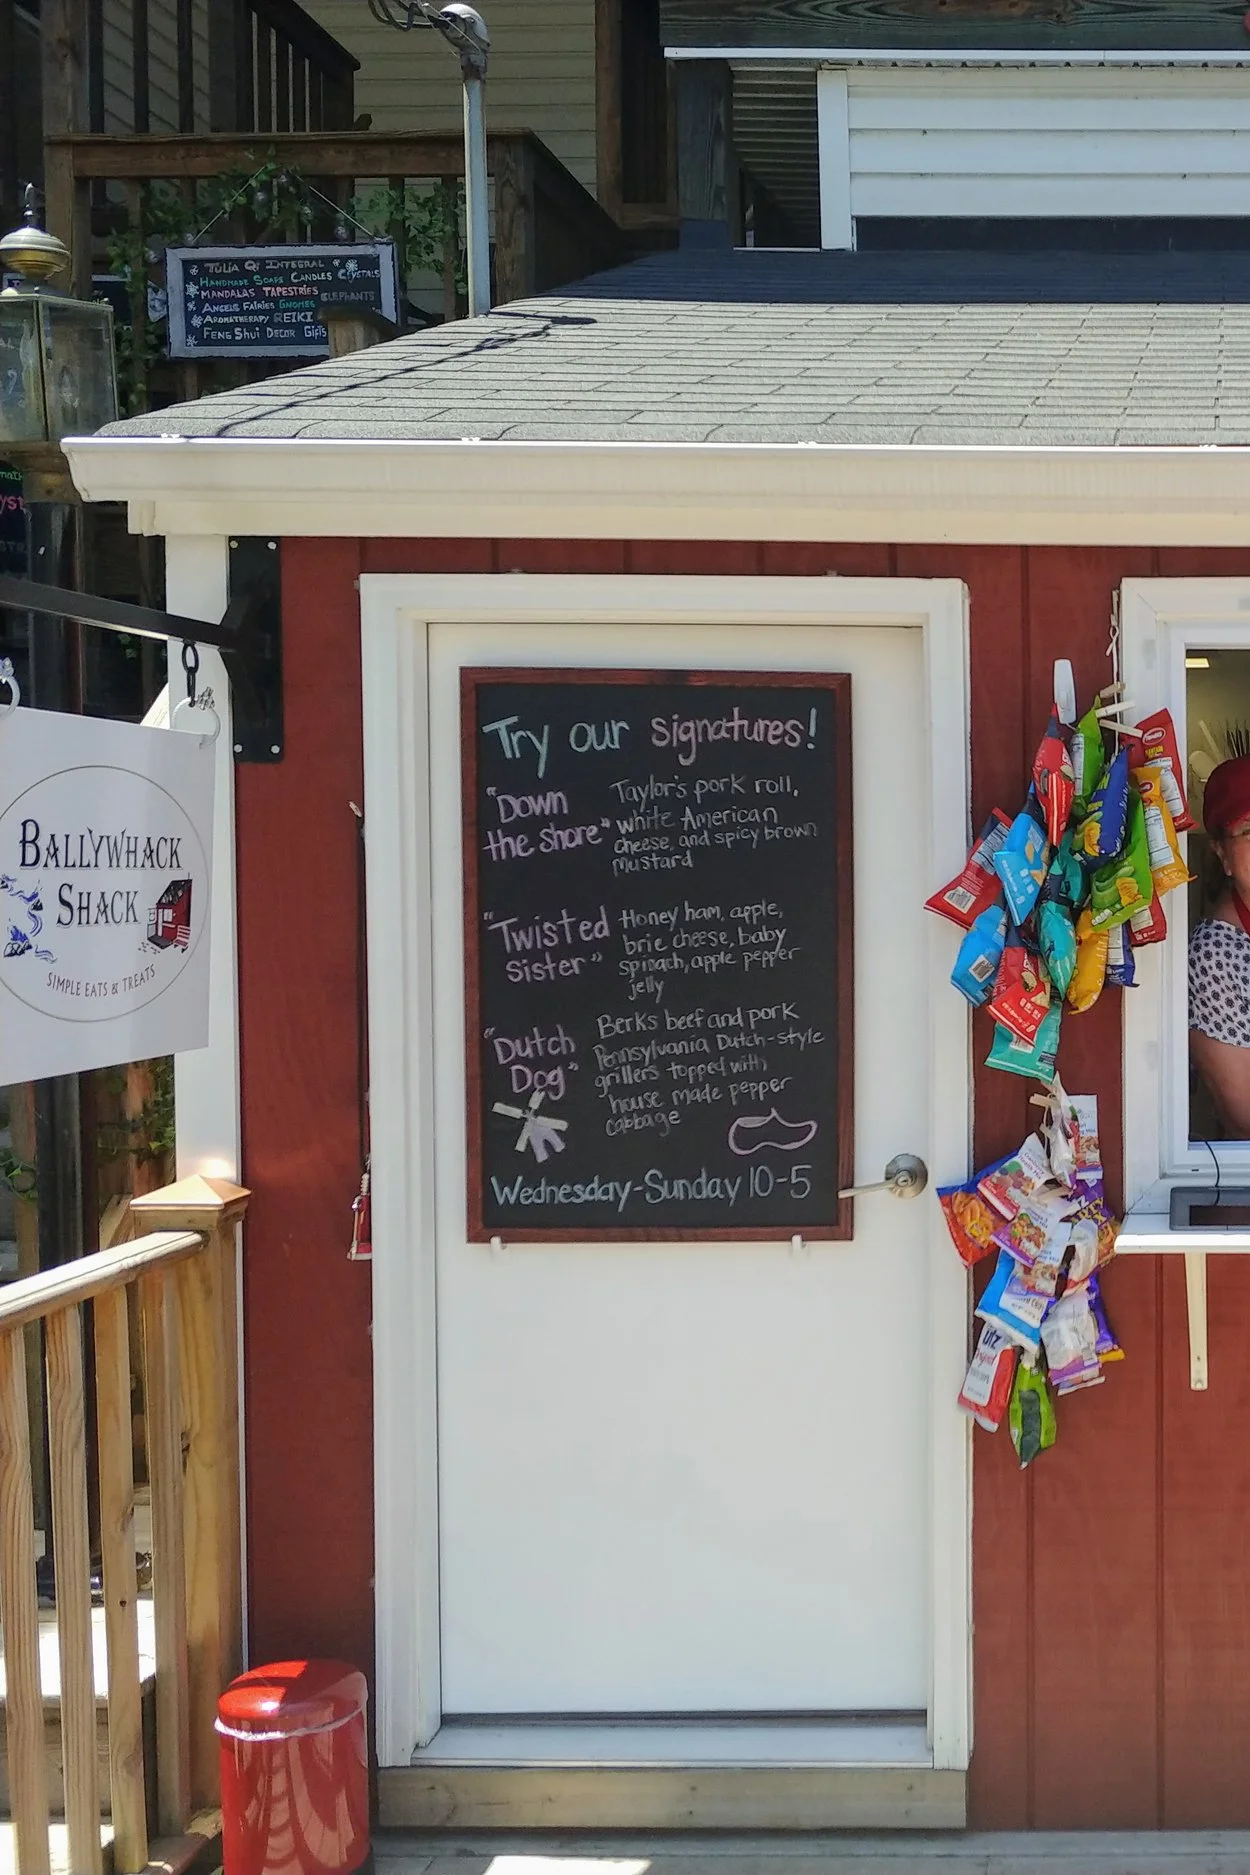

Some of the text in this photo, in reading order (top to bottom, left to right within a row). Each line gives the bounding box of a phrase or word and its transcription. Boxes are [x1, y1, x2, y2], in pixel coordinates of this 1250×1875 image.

[201, 286, 255, 300] MANDALAS
[290, 271, 333, 283] CANDLES
[202, 302, 240, 314] ANGELS
[278, 299, 316, 310] GNOMES
[274, 311, 313, 324] REIKI
[482, 715, 549, 780] Try
[568, 719, 631, 753] our
[608, 773, 799, 813] Taylor's pork roll,
[616, 805, 779, 835] white American
[679, 830, 711, 849] and
[714, 825, 760, 849] spicy
[764, 822, 819, 841] brown
[19, 818, 182, 870] BALLYWHACK
[482, 828, 536, 862] the
[611, 849, 694, 877] mustard
[56, 882, 142, 927] SHACK
[617, 898, 784, 932] Honey ham, apple,
[622, 924, 787, 956] brie cheese, baby
[47, 963, 156, 997] SIMPLE EATS & TREATS
[618, 947, 801, 979] spinach, apple pepper
[627, 974, 665, 1003] jelly
[597, 1002, 800, 1040] Berks beef and pork
[592, 1026, 825, 1072] Pennsylvania Dutch-style
[594, 1052, 768, 1099] grillers topped with
[608, 1076, 793, 1115] house made pepper
[605, 1110, 682, 1137] cabbage
[749, 1164, 813, 1199] 10-5
